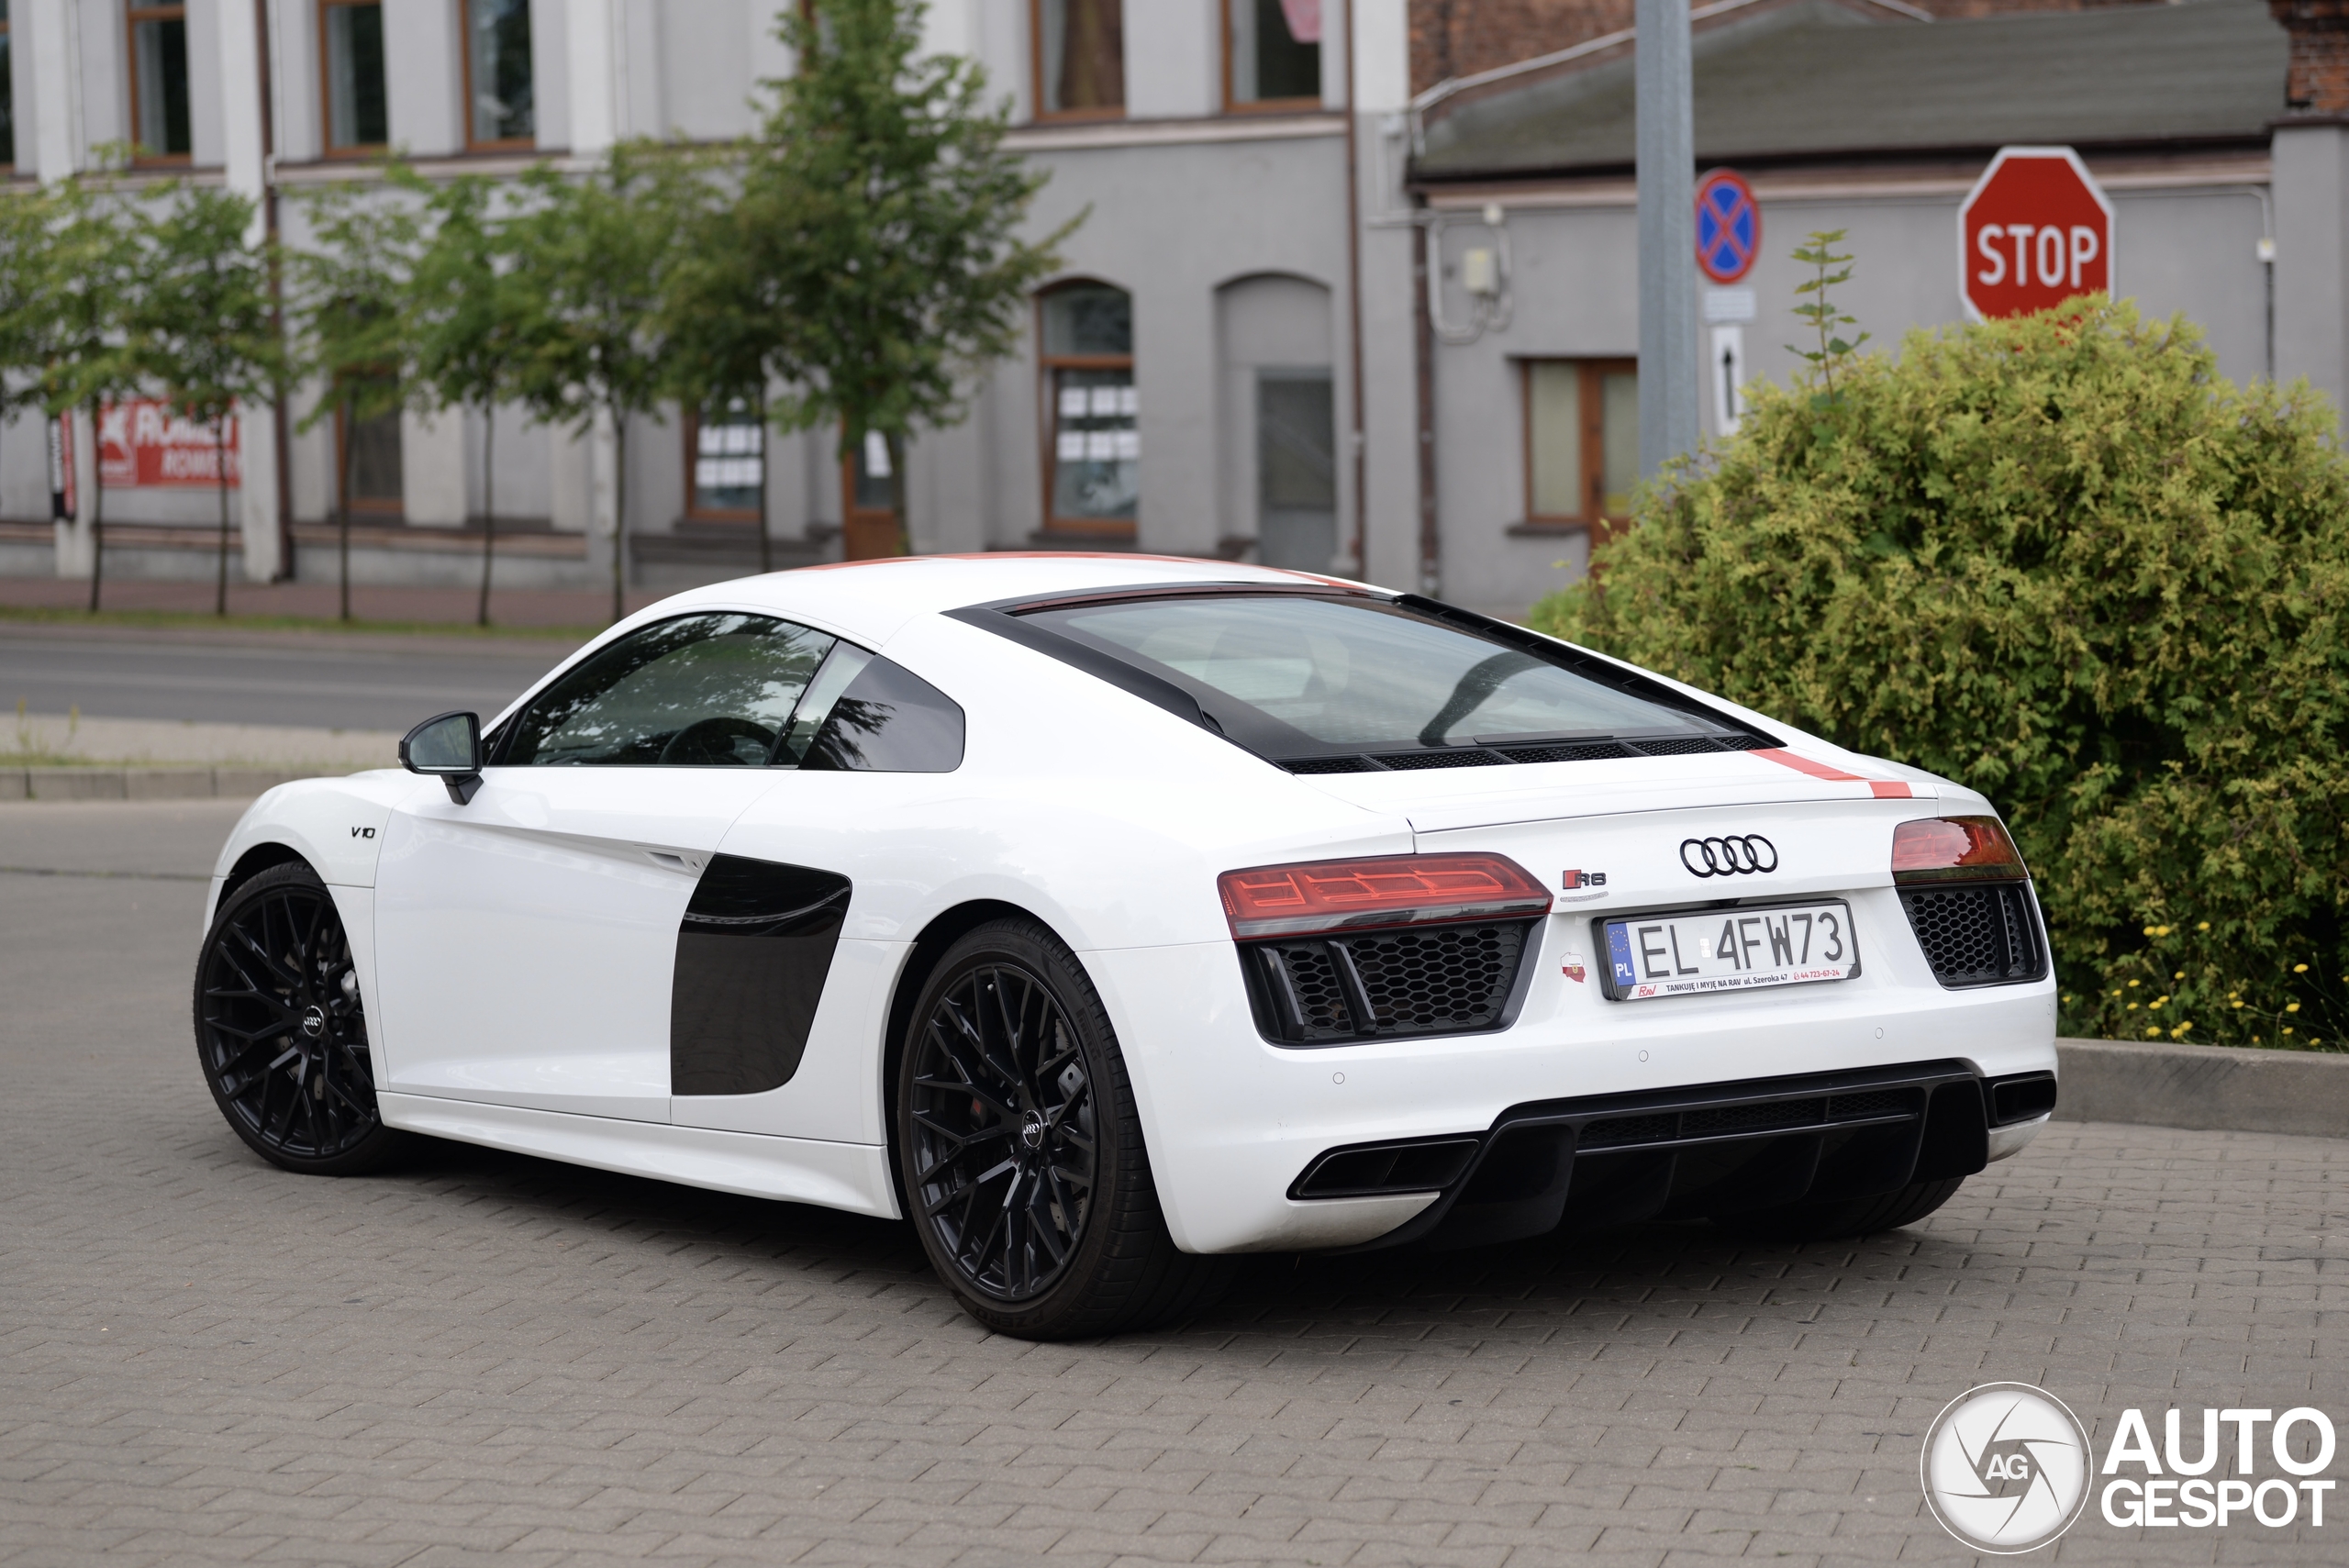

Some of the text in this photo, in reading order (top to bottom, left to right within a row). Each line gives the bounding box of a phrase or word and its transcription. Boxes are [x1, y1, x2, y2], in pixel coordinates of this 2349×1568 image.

[1977, 223, 2099, 287] STOP
[351, 826, 375, 839] V10
[1574, 872, 1607, 886] R8
[1638, 911, 1843, 979] EL 4FW73
[1615, 962, 1632, 978] PL
[1800, 969, 1841, 980] 44 723-67-24
[1666, 982, 1696, 992] TANKUJĘ
[1700, 981, 1717, 990] MYJĘ
[1728, 978, 1742, 986] RAV
[1753, 974, 1780, 984] Szeroka
[1780, 973, 1788, 982] 47
